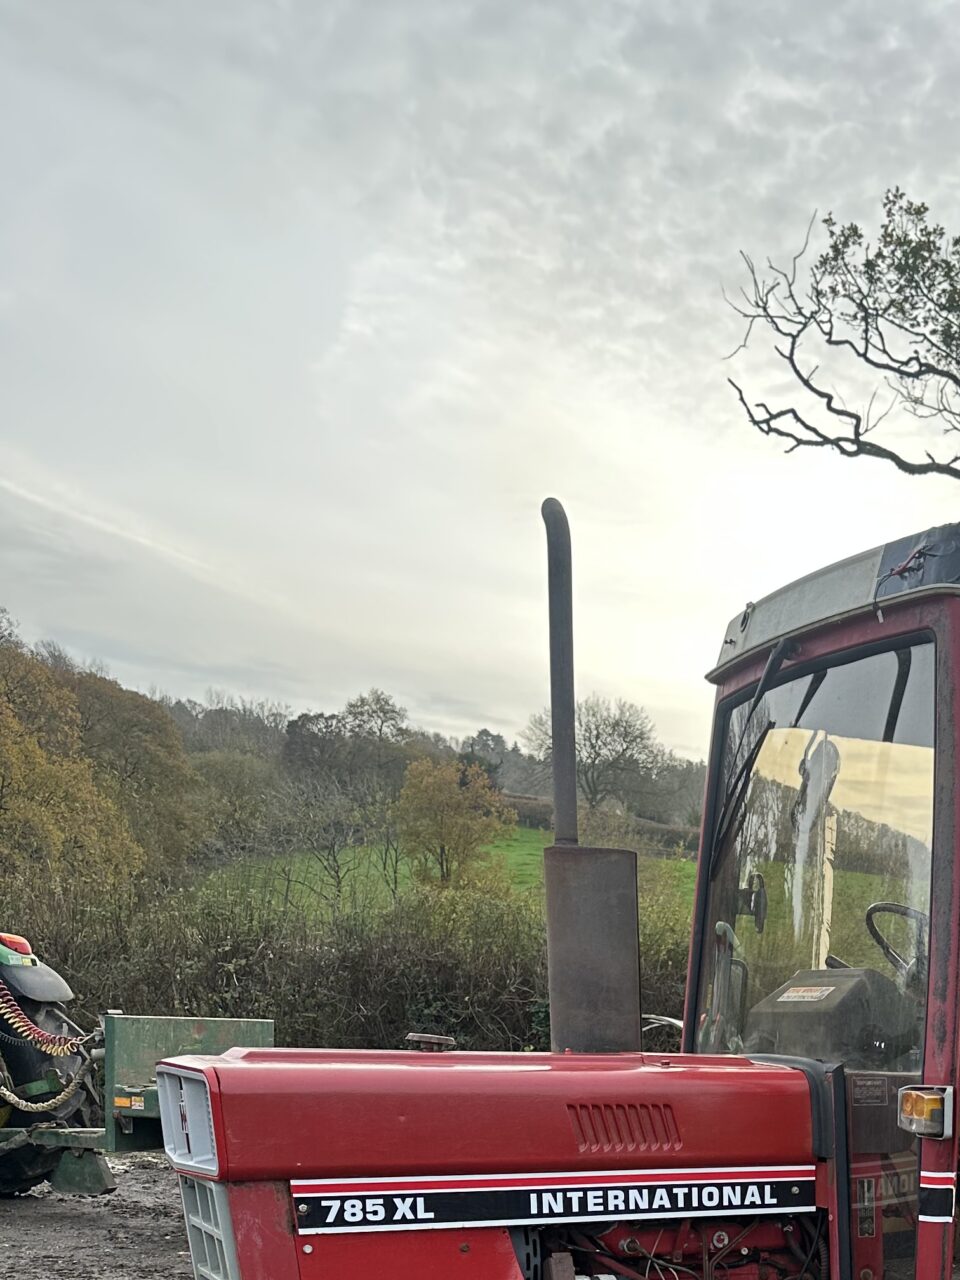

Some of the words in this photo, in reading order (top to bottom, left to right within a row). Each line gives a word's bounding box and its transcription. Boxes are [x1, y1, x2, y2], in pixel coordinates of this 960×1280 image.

[321, 1198, 386, 1223] 785
[392, 1196, 435, 1221] XL
[530, 1184, 778, 1215] INTERNATIONAL
